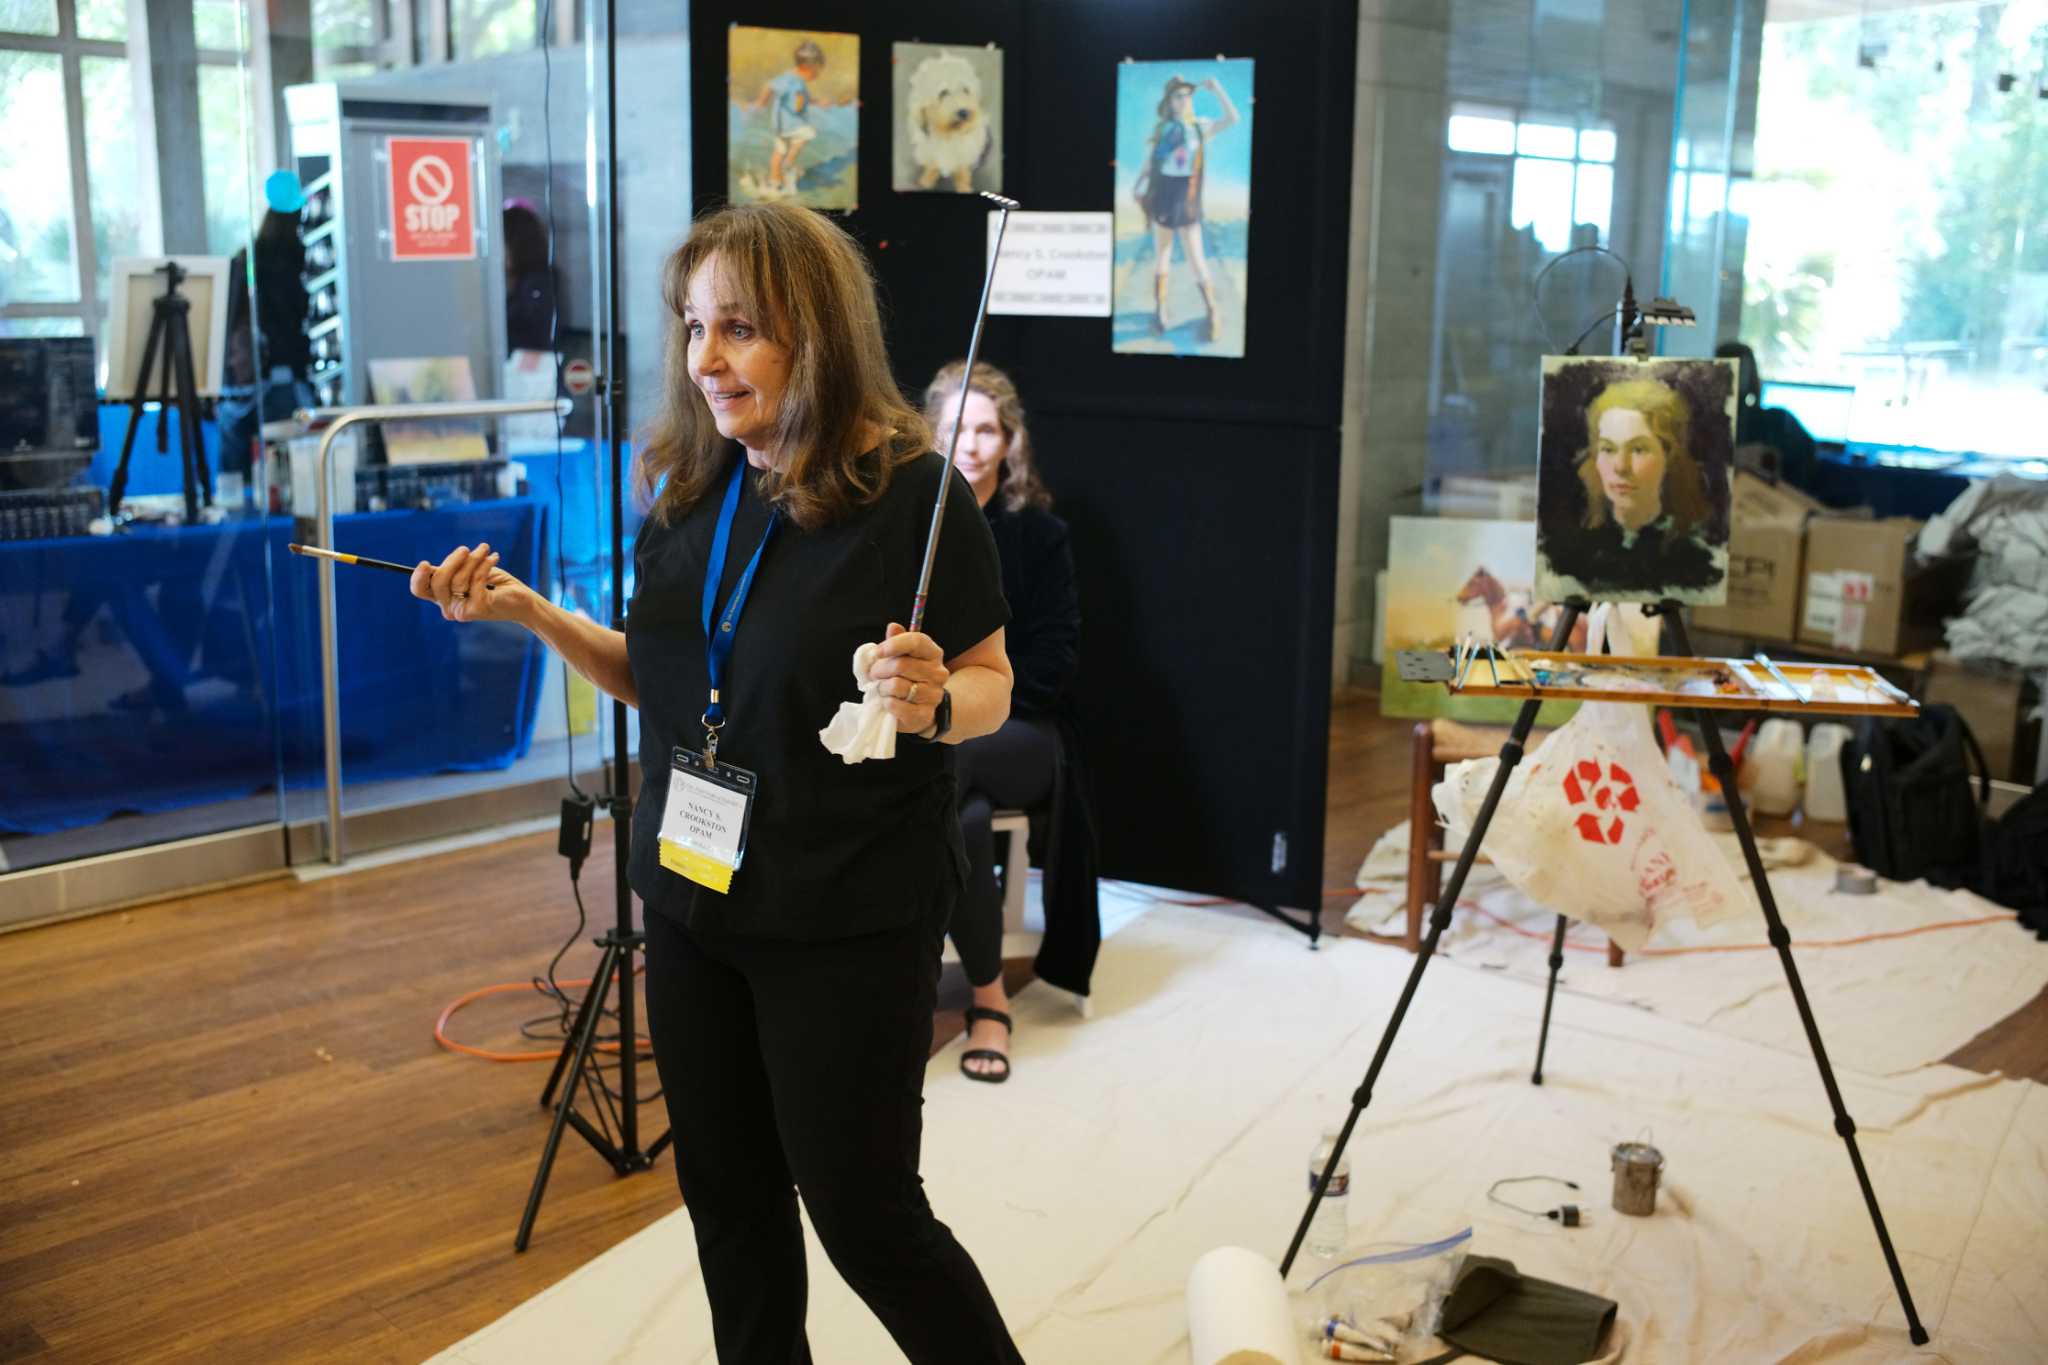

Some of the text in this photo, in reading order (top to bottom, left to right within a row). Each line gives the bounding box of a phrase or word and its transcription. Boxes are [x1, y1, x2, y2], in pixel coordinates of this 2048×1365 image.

[404, 203, 460, 231] STOP
[688, 801, 713, 817] NANCY
[680, 809, 727, 833] CROOKSTON
[689, 825, 712, 839] OPAM
